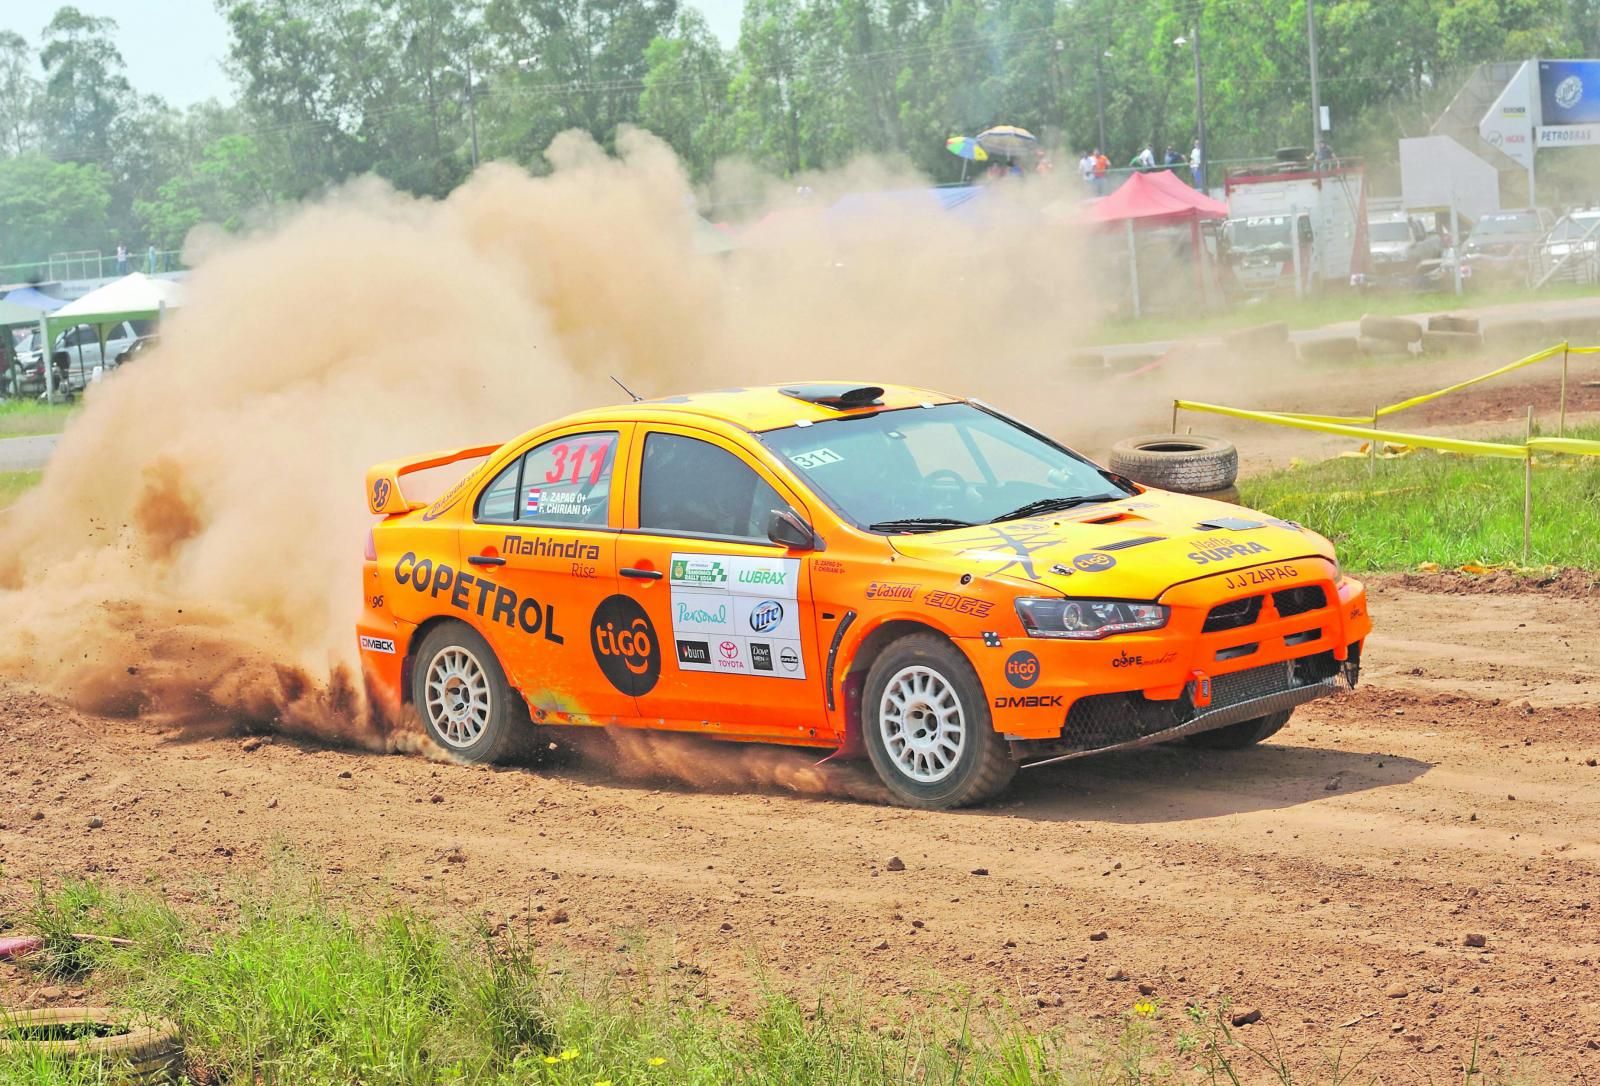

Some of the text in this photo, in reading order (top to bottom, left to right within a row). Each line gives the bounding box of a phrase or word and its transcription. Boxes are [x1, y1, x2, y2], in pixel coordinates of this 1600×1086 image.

[1541, 129, 1592, 141] PETROBRAS
[545, 443, 609, 485] 311
[794, 449, 839, 469] 311
[550, 492, 576, 503] ZAPAG
[546, 504, 581, 515] CHIRIANI
[502, 534, 600, 560] Mahindra
[1187, 541, 1272, 565] SUPRA
[738, 570, 786, 586] LUBRAX
[1249, 565, 1298, 585] ZAPAG
[394, 551, 565, 646] COPETROL
[876, 583, 915, 599] Castrol
[677, 602, 727, 625] Personal
[924, 589, 996, 619] EDGE
[755, 606, 780, 629] Lite
[687, 645, 706, 660] burn
[751, 645, 769, 656] Dove
[718, 660, 745, 669] TOYOTA
